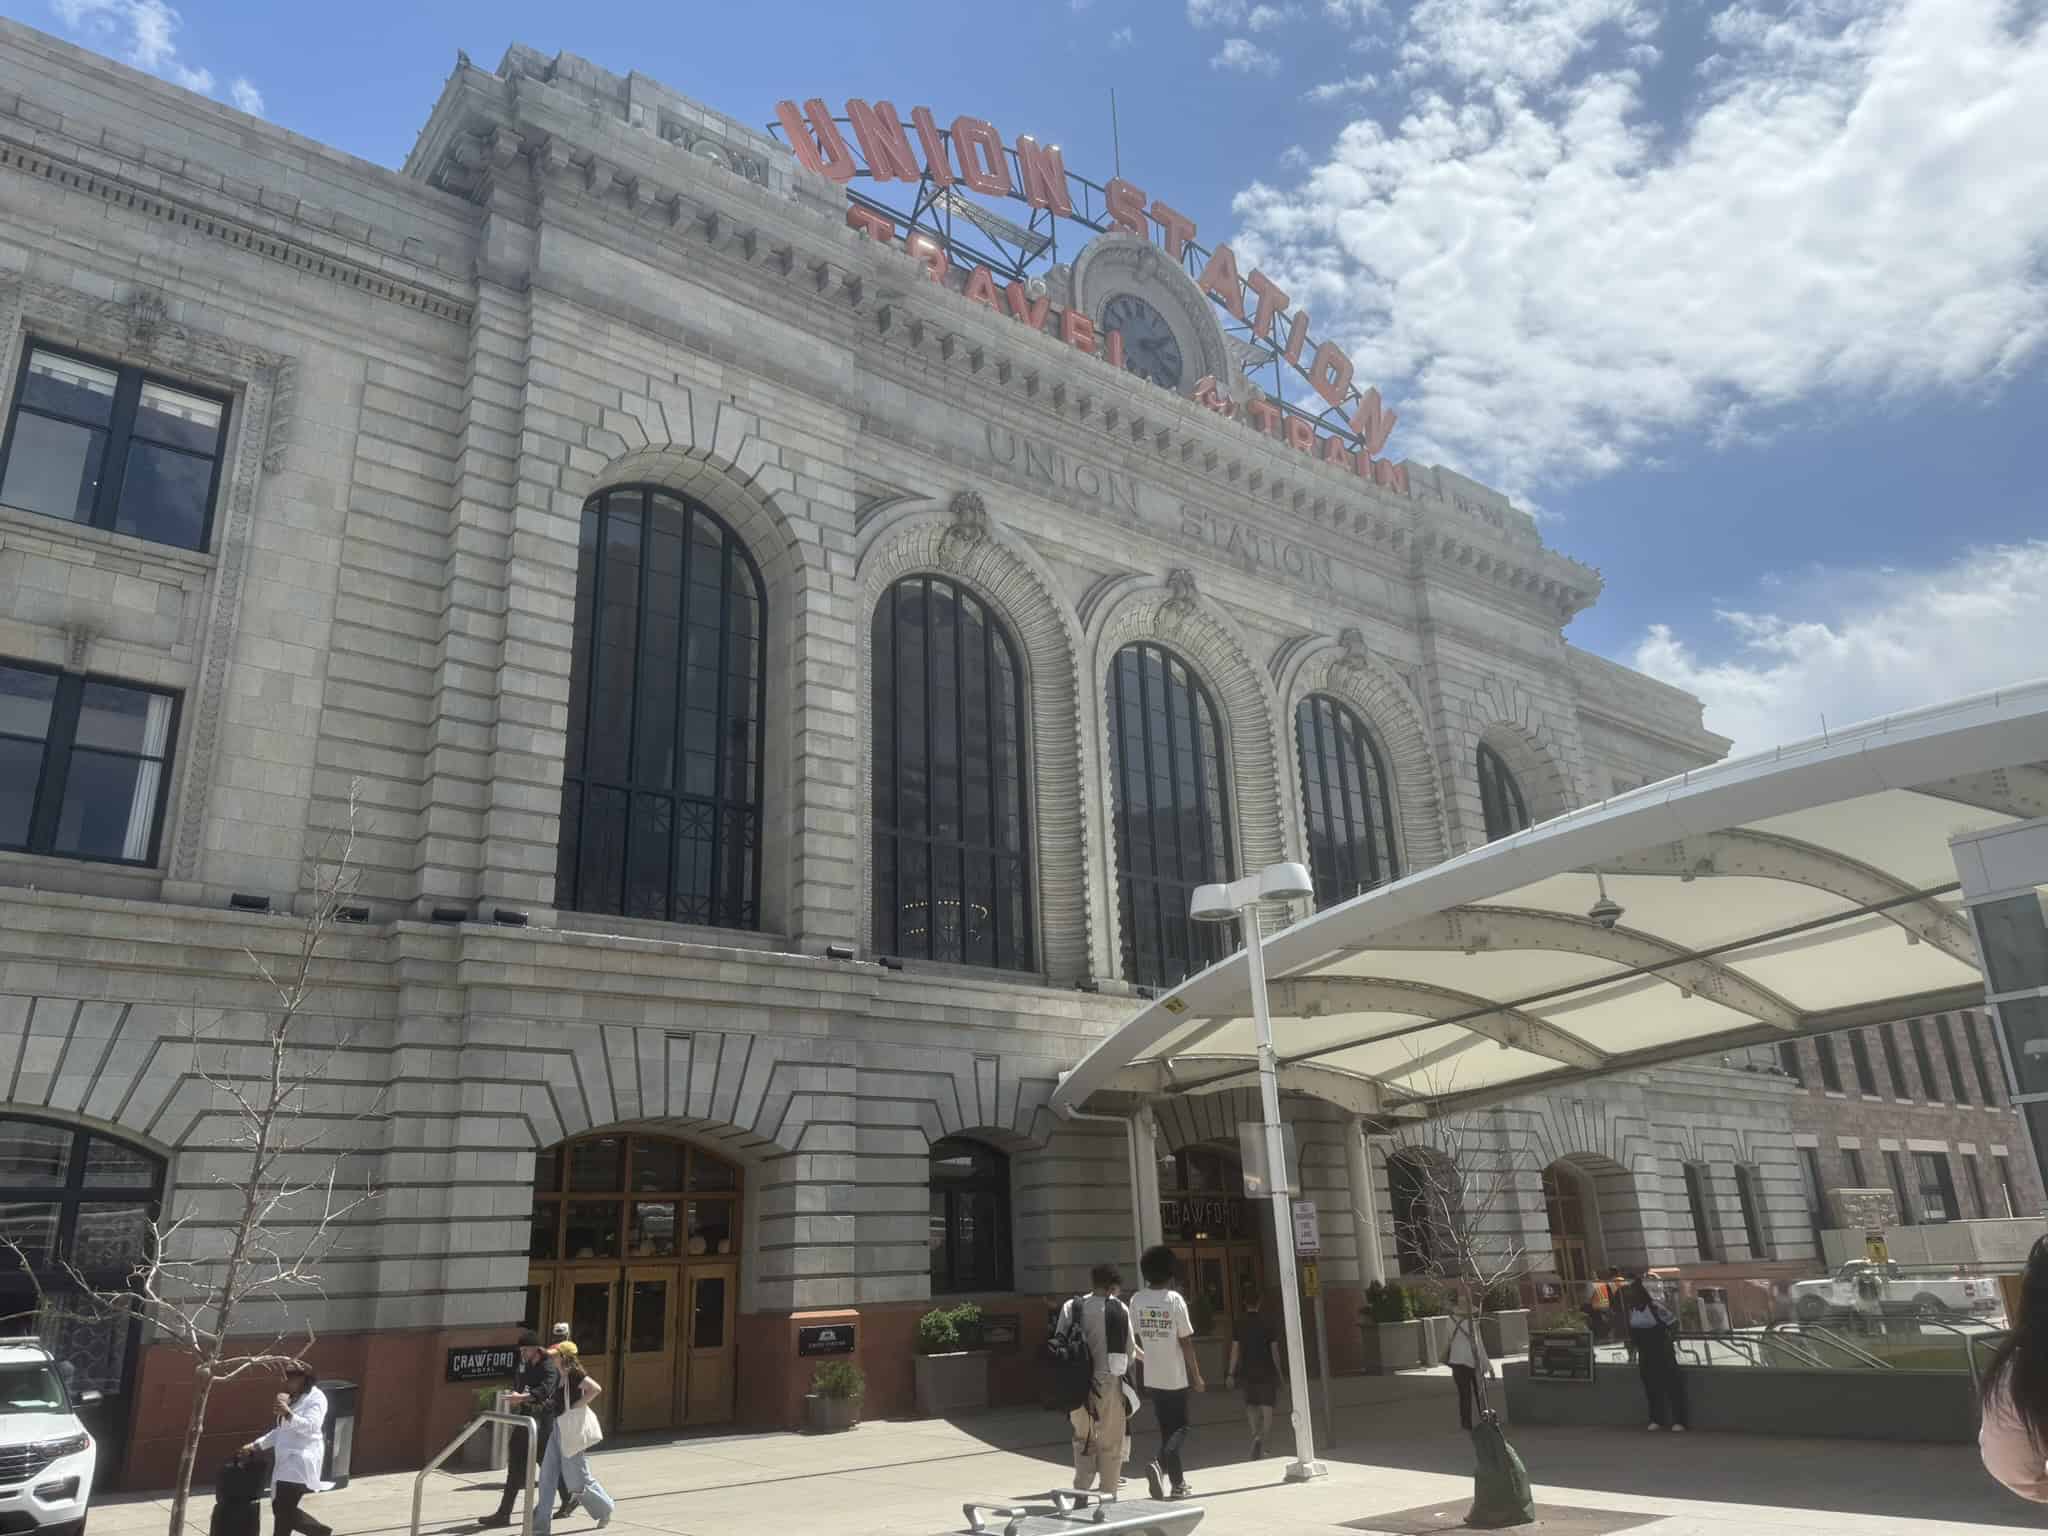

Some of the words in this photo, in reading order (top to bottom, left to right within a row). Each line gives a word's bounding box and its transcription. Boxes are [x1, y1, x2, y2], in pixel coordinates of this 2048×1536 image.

[775, 98, 1073, 217] UNION
[1105, 176, 1398, 455] STATION
[986, 422, 1141, 519] UNION
[1181, 503, 1334, 590] STATION
[1247, 399, 1408, 495] TRAIN
[453, 1351, 514, 1372] CRAWFORD
